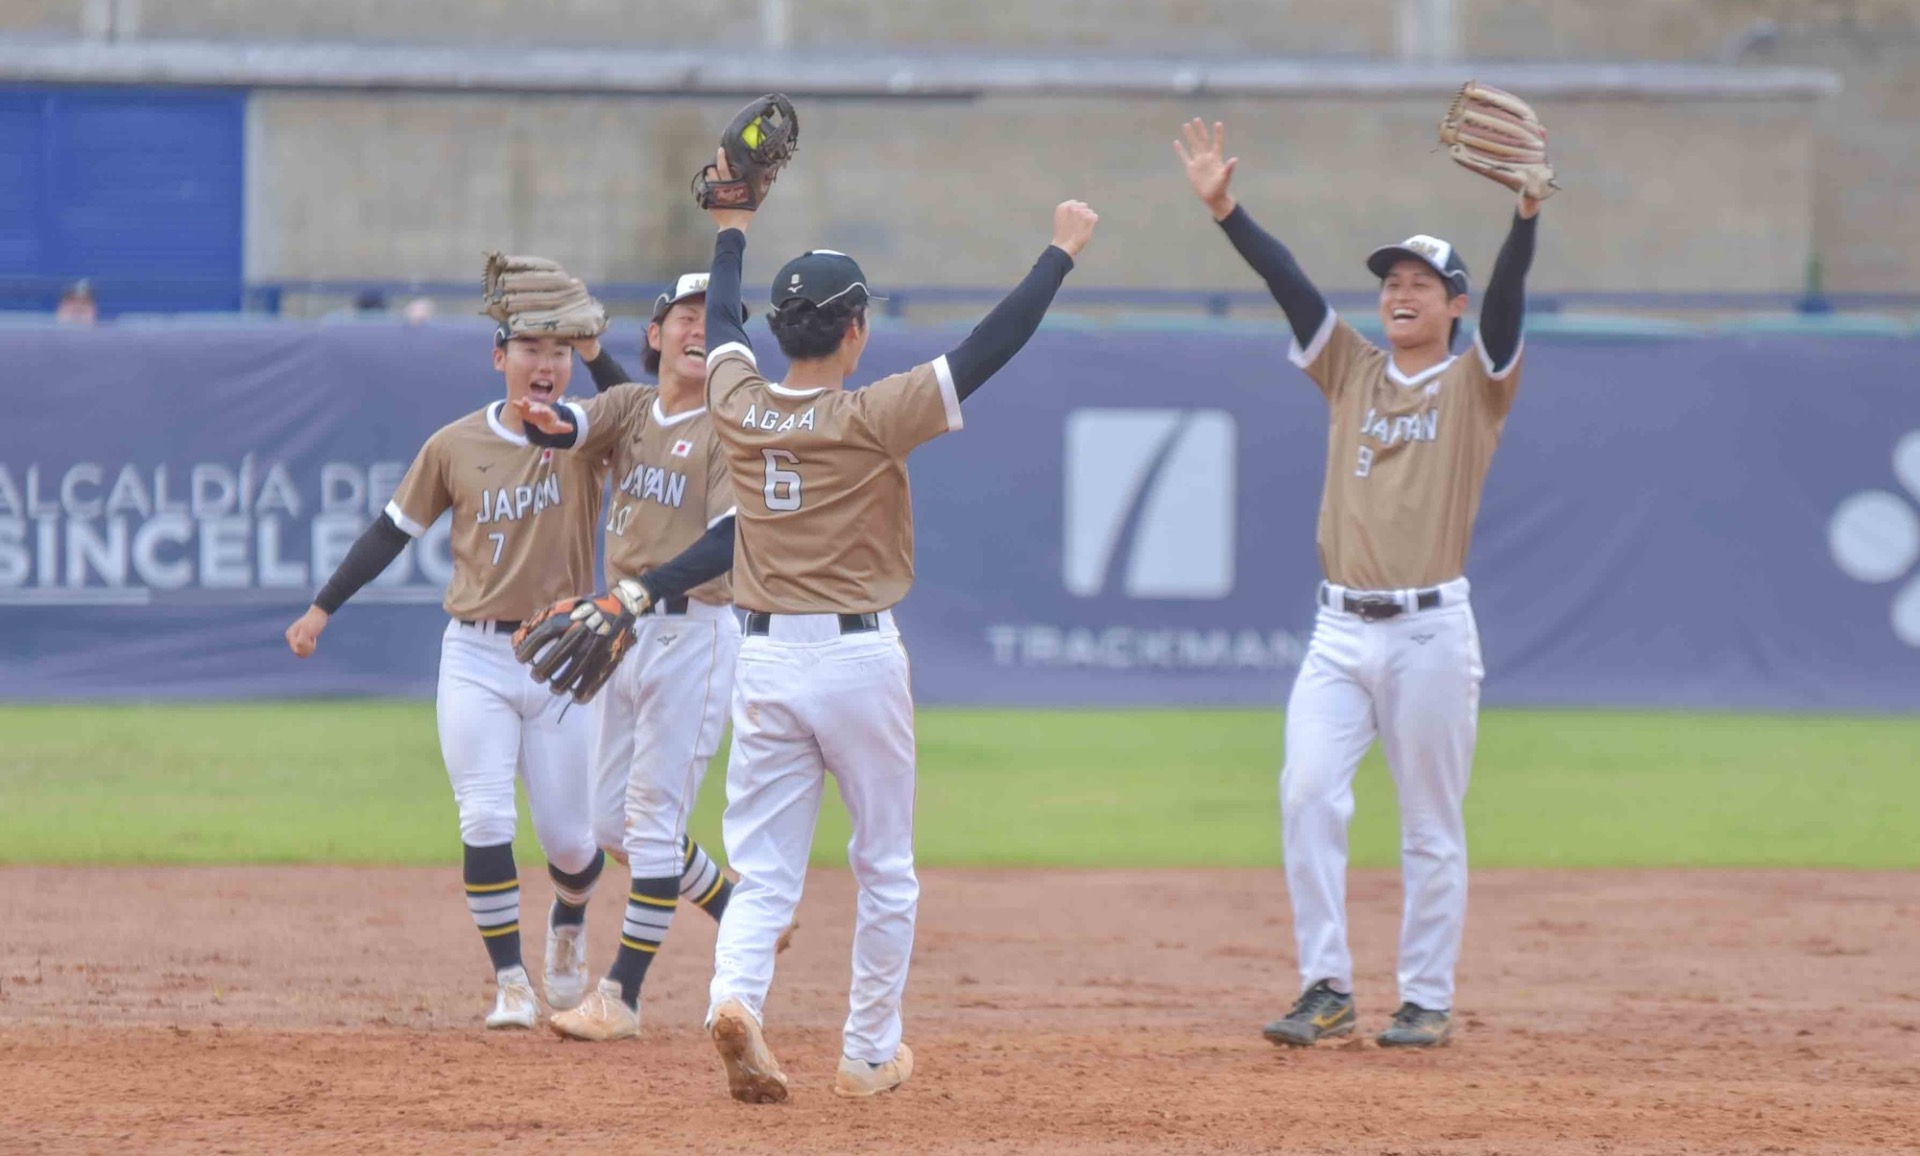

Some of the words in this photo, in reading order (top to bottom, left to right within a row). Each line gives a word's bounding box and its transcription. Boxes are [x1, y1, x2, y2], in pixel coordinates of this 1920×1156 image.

[1359, 407, 1439, 444] JAPAN
[0, 452, 300, 519] ALCALDÍA
[320, 463, 407, 519] DE
[476, 472, 562, 524] JAPAN
[619, 463, 687, 509] JAPAN
[761, 448, 803, 511] 6
[488, 531, 506, 565] 7
[985, 624, 1306, 668] TRACKMAN
